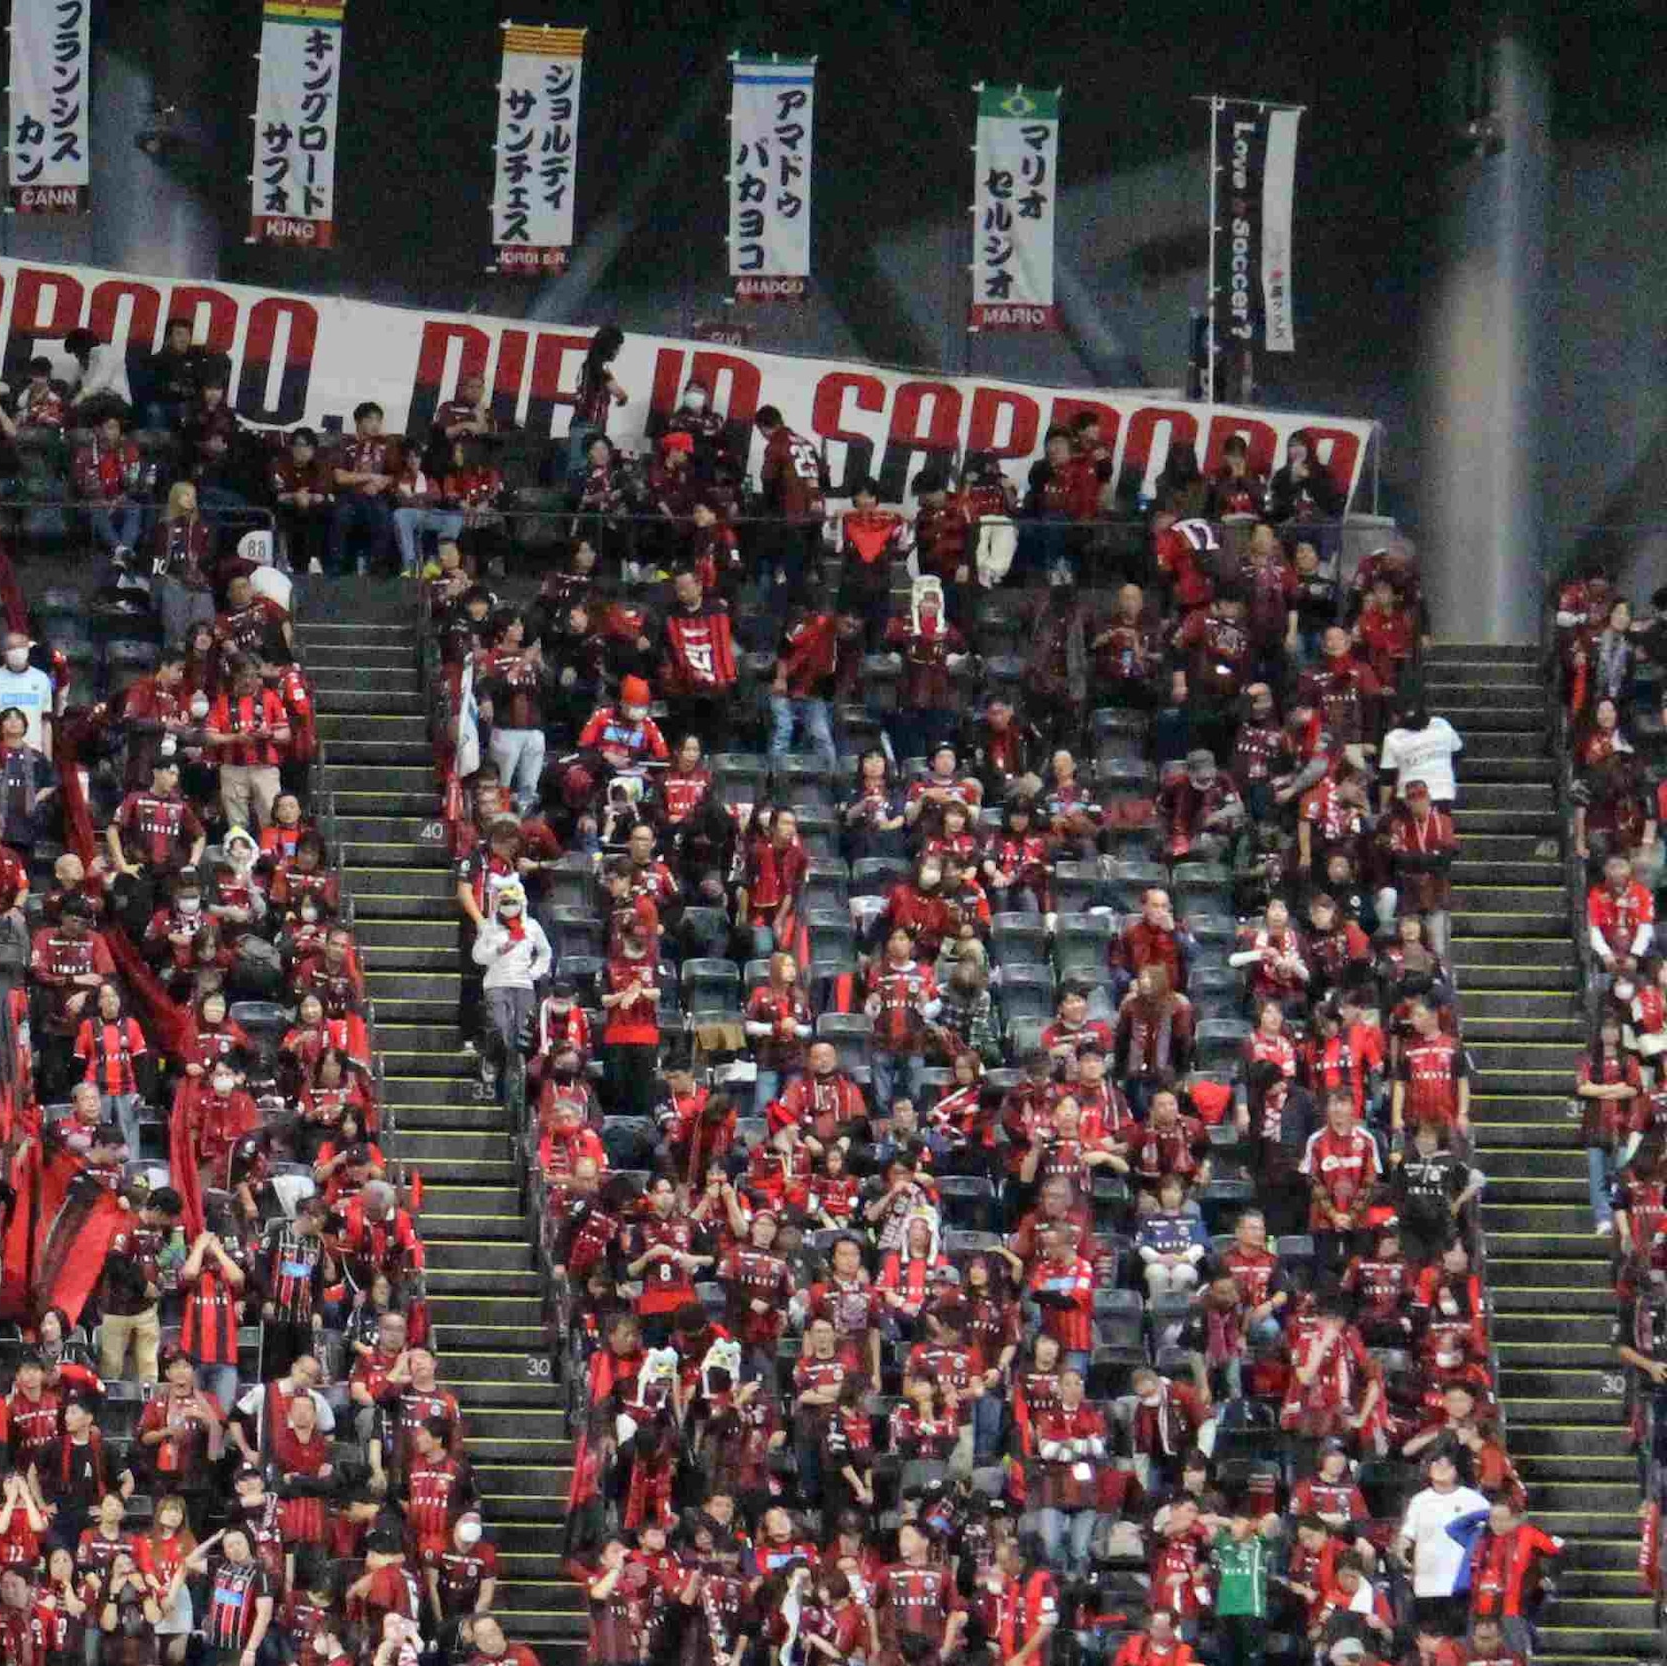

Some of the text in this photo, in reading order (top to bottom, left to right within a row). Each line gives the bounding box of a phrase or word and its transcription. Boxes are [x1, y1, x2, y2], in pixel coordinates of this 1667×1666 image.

[17, 115, 45, 183] カン
[1018, 124, 1051, 220] マリオ
[265, 222, 318, 239] KING
[982, 306, 1046, 326] MARIO
[420, 822, 444, 840] 40
[526, 1358, 551, 1378] 30
[1601, 1375, 1626, 1393] 30
